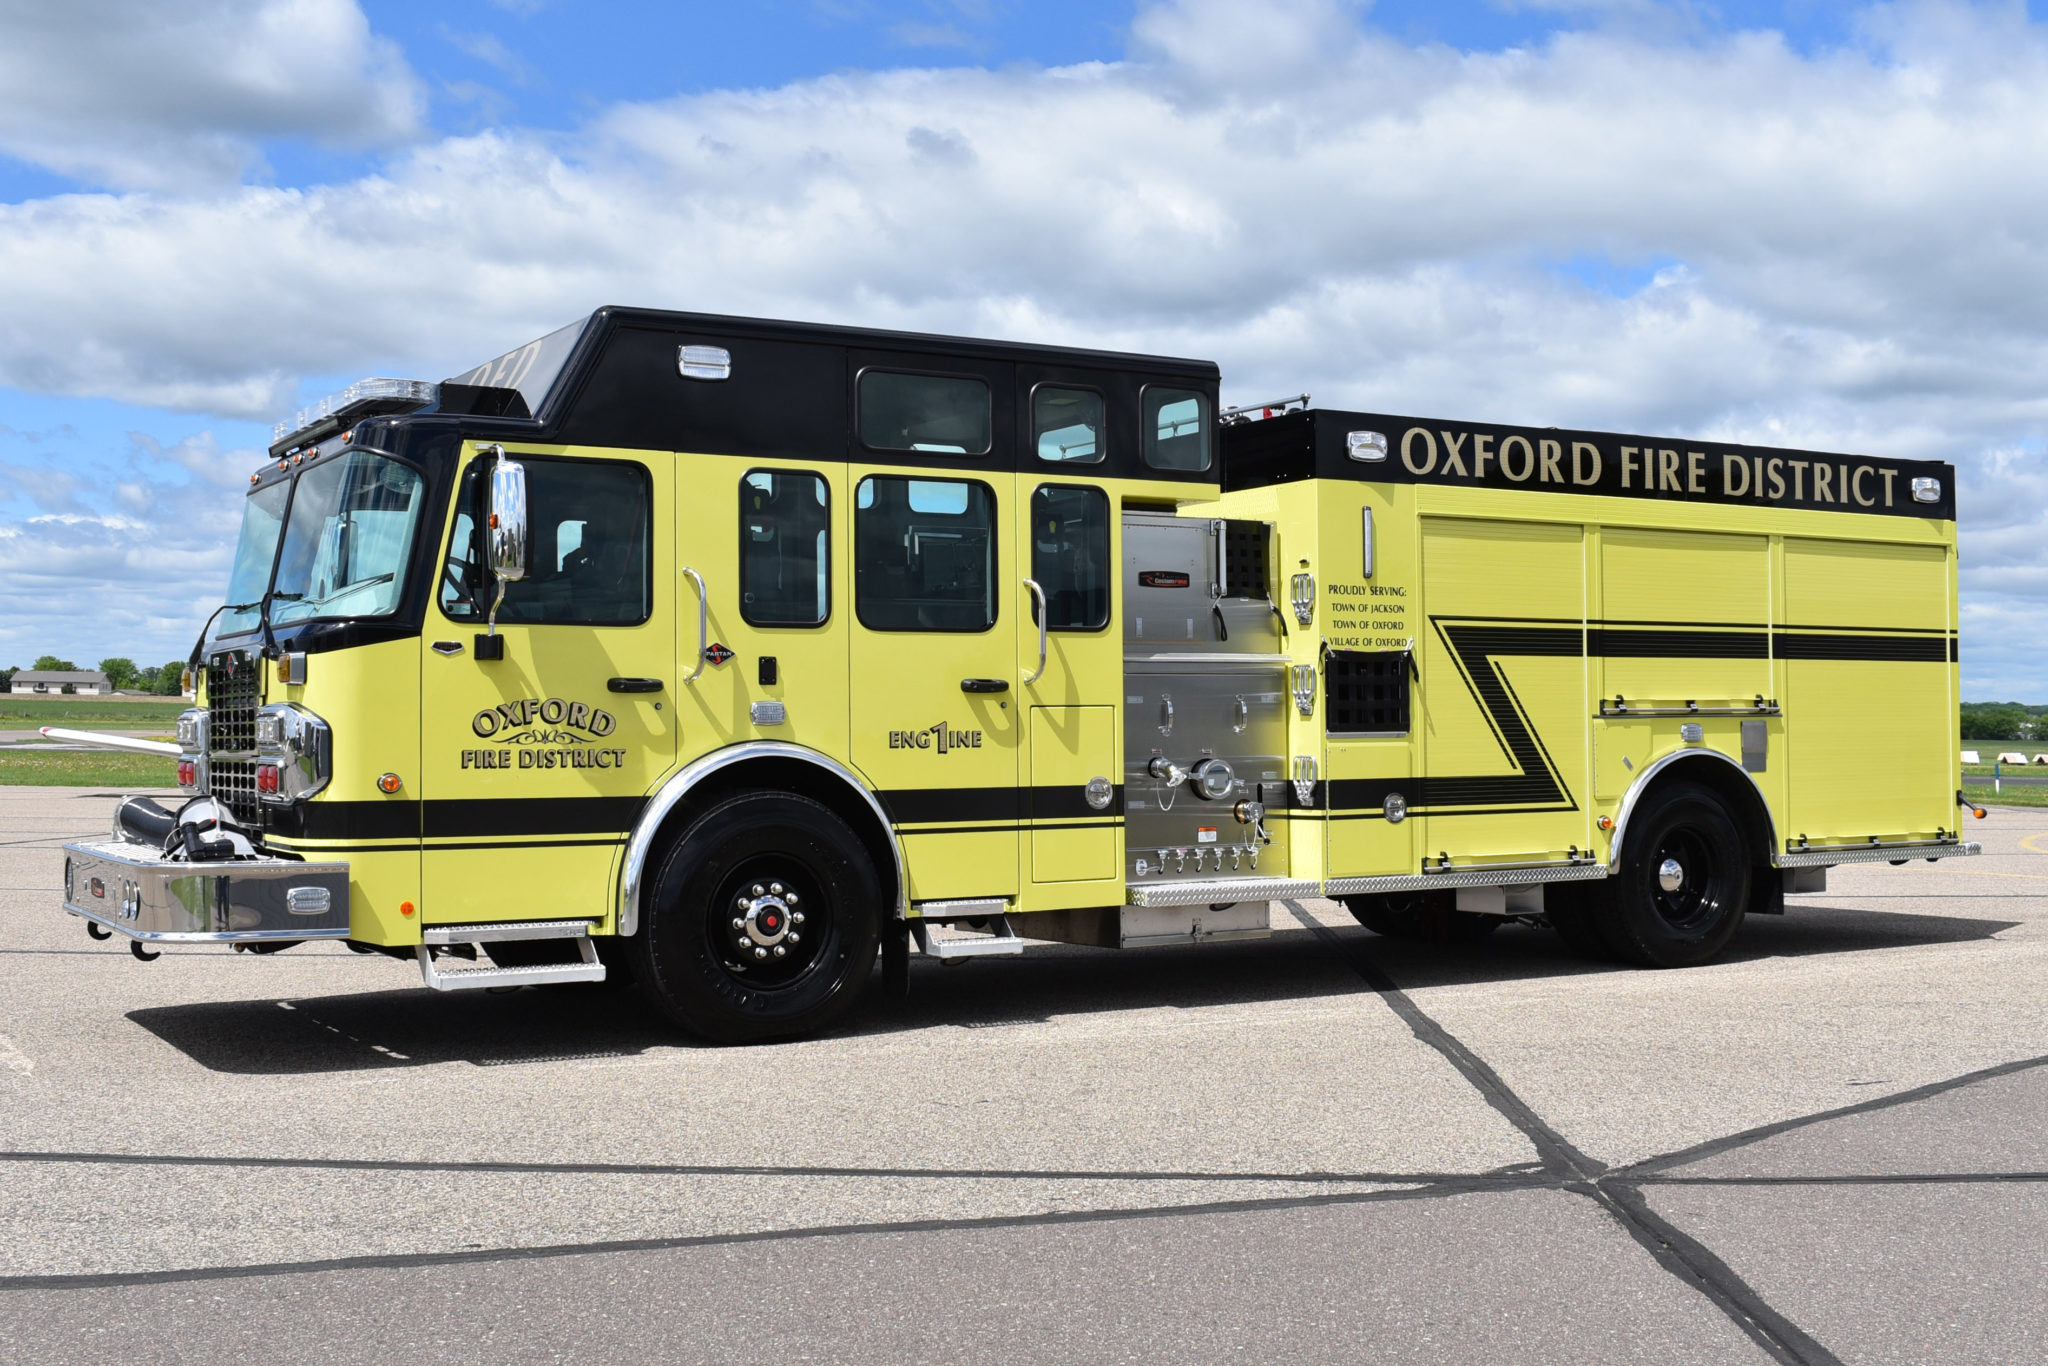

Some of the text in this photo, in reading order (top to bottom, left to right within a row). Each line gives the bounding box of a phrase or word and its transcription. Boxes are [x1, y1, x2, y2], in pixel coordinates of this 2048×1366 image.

[1400, 426, 1899, 508] OXFORD FIRE DISTRICT
[1328, 584, 1407, 597] PROUDLY SERVING:
[1331, 602, 1405, 614] TOWN OF JACKSON
[1332, 619, 1404, 631] TOWN OF OXFORD
[1329, 637, 1408, 647] VILLAGE OF OXFORD
[472, 697, 617, 739] OXFORD
[461, 748, 627, 770] FIRE DISTRICT
